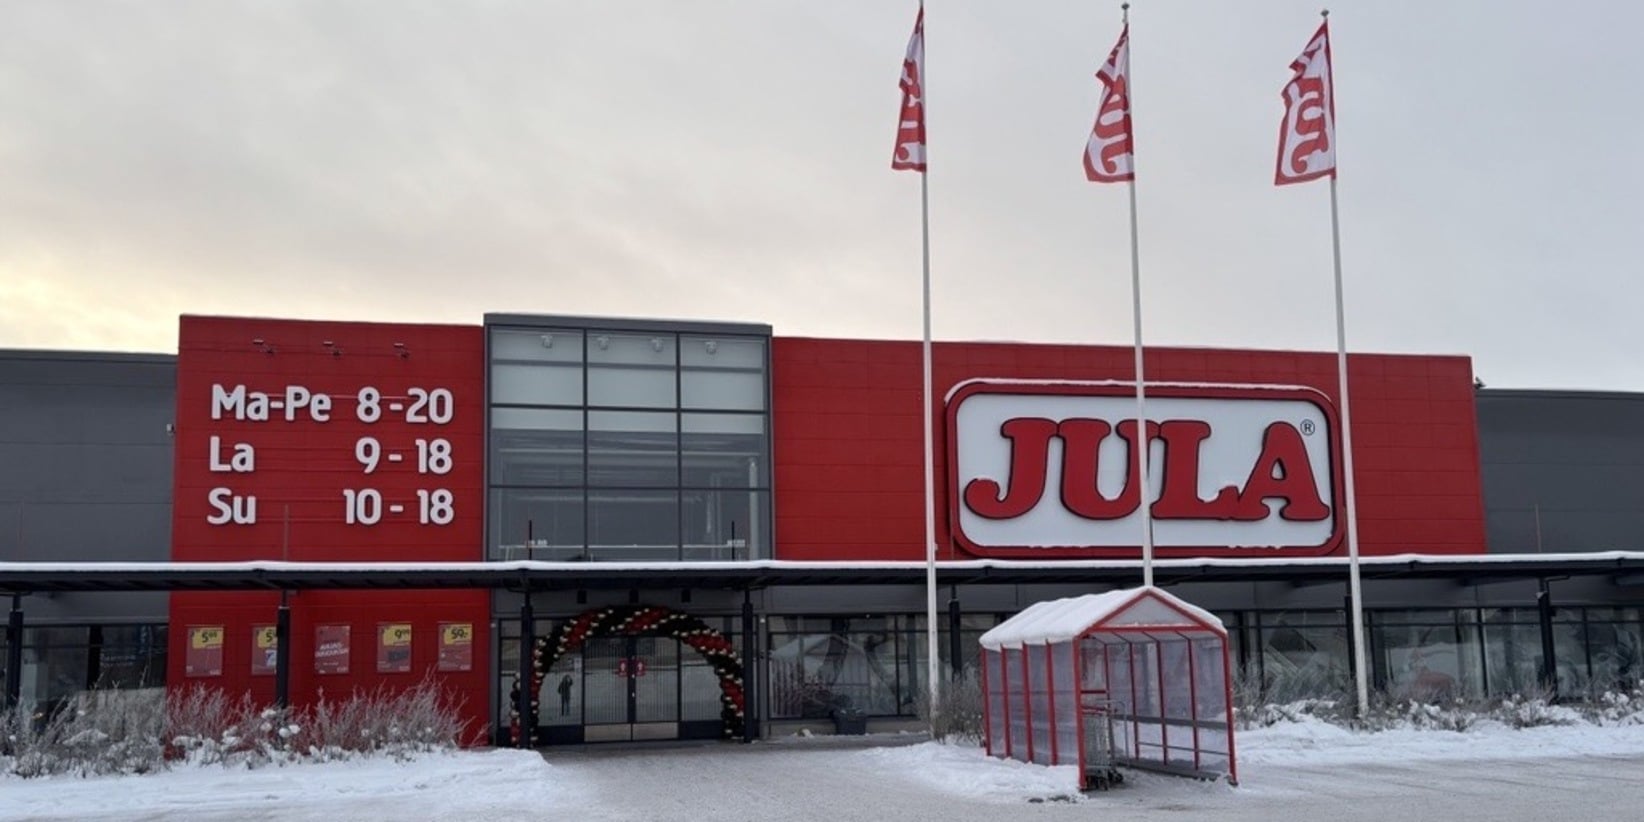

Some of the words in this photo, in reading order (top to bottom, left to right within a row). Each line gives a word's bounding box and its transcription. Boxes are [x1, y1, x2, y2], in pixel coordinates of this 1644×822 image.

[211, 384, 331, 422] Ma-Pe
[356, 386, 381, 423] 8
[210, 436, 254, 472] La
[355, 437, 381, 473] 9
[415, 439, 452, 474] 18
[963, 417, 1331, 521] JULA
[207, 487, 256, 524] Su
[343, 489, 382, 524] 10
[417, 489, 454, 525] 18
